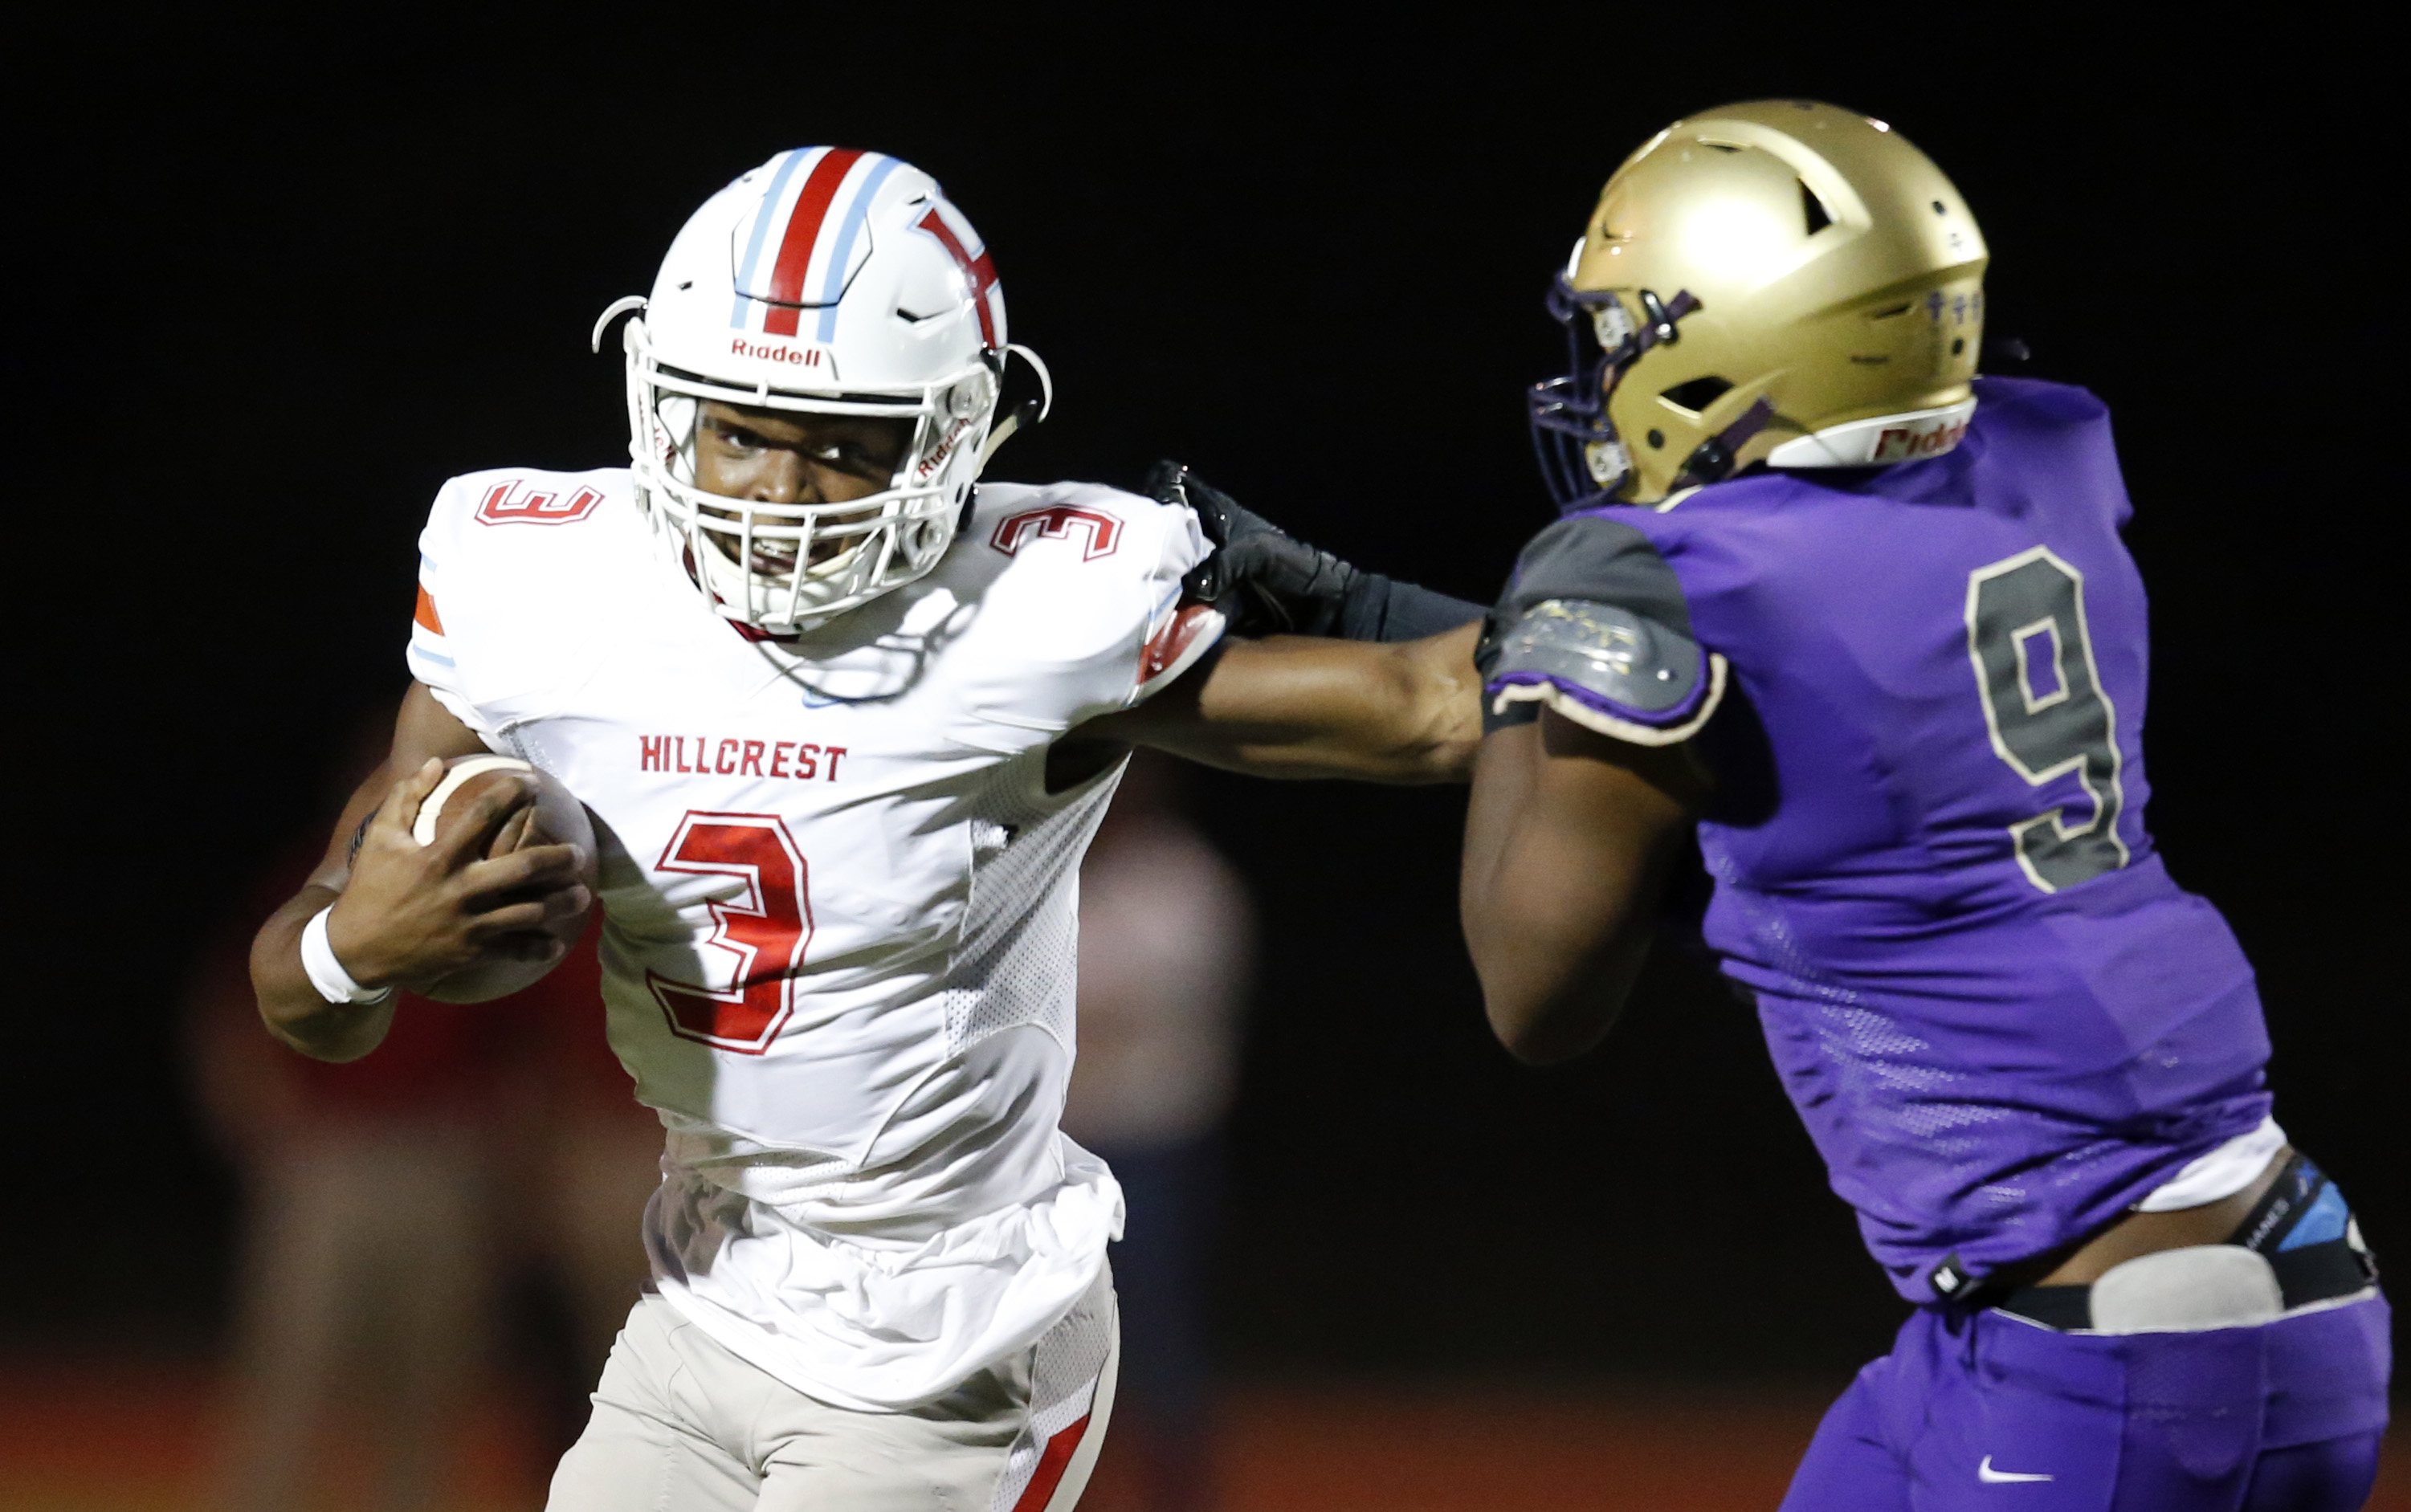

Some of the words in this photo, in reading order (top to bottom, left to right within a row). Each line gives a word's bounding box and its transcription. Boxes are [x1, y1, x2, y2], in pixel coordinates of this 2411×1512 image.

[731, 337, 821, 367] Riddell
[474, 479, 606, 527] 3
[989, 503, 1125, 563] 3
[1963, 544, 2131, 895] 9
[638, 735, 848, 782] HILLCREST
[645, 809, 815, 1056] 3
